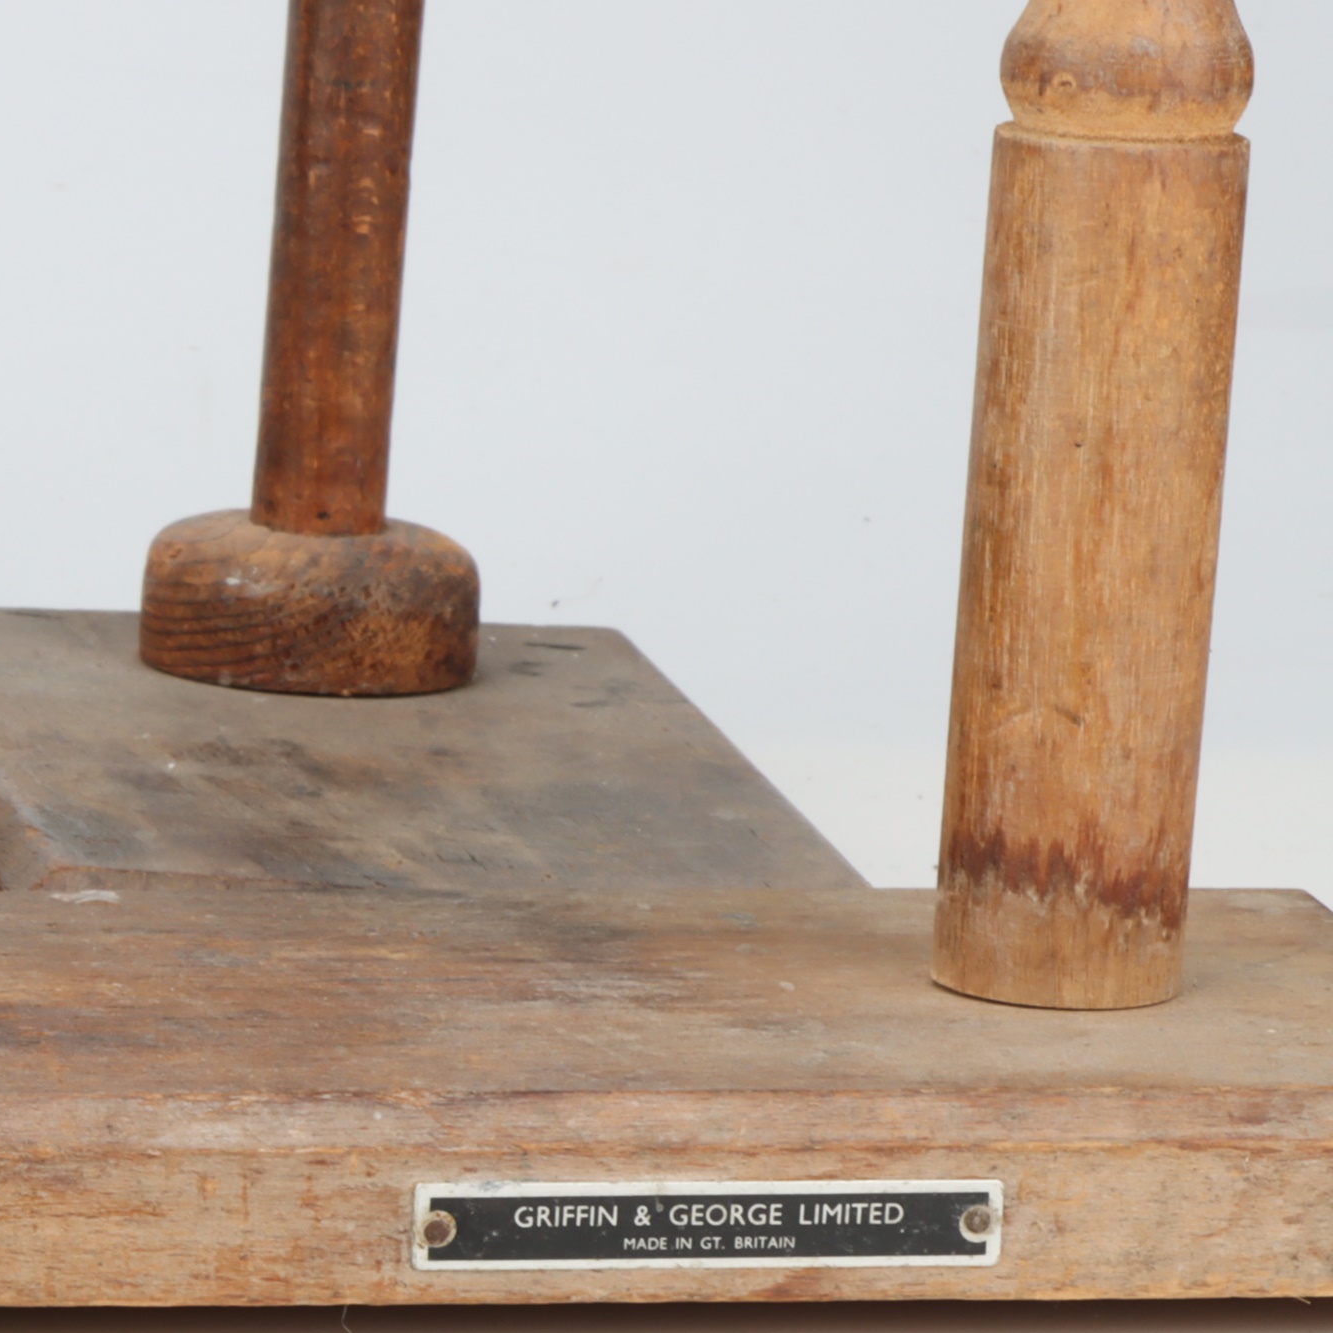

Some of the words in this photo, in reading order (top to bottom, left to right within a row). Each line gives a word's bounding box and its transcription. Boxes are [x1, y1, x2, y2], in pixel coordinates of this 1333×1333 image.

[514, 1205, 618, 1228] GRIFFIN
[634, 1205, 651, 1226] &
[669, 1203, 783, 1226] GEORGE
[799, 1202, 904, 1225] LIMITED
[623, 1238, 668, 1251] MADE
[675, 1237, 693, 1250] IN
[700, 1236, 725, 1250] GT.
[734, 1236, 796, 1249] BRITAIN
